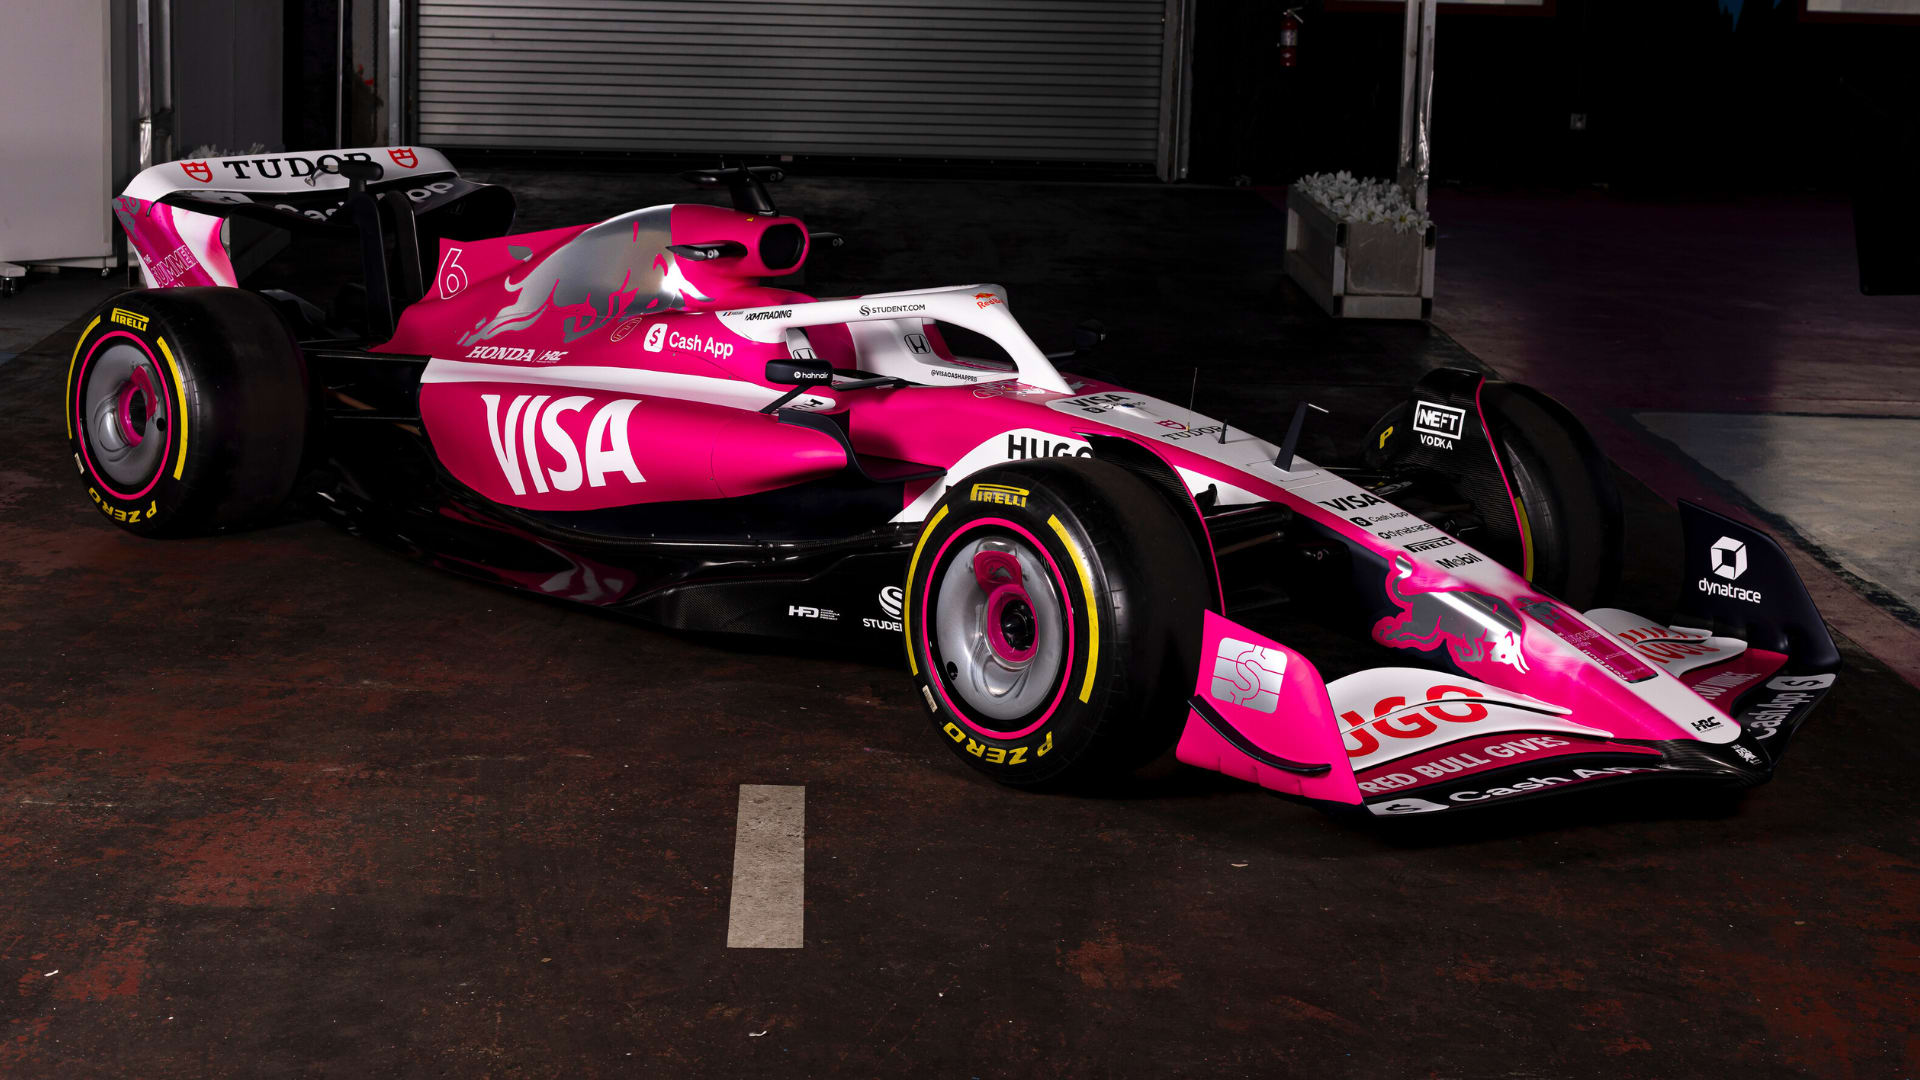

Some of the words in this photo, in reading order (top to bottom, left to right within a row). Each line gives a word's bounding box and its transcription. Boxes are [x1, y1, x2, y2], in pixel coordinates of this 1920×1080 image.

[438, 248, 468, 300] 6
[110, 307, 150, 332] PIRELLI
[871, 304, 926, 314] STUDENT.COM
[465, 346, 536, 362] HONDA
[669, 331, 702, 352] Cash
[703, 336, 734, 360] App
[1418, 408, 1459, 432] NEFT
[480, 394, 647, 496] VISA
[1420, 434, 1453, 450] VODKA
[88, 487, 142, 524] ZERO
[970, 484, 1030, 508] PIRELLI
[1318, 493, 1385, 512] VISA
[146, 501, 158, 518] P
[1368, 513, 1391, 523] Cash
[1391, 511, 1411, 520] App
[1386, 524, 1434, 537] dynatrace
[1402, 536, 1457, 553] PIRELLI
[1435, 553, 1483, 569] Mobil
[1699, 578, 1761, 604] dynatrace
[1755, 692, 1815, 709] App
[1746, 709, 1792, 740] Cash
[943, 721, 1028, 766] ZERO
[1036, 731, 1054, 758] P
[1357, 772, 1417, 794] RED
[1412, 752, 1491, 779] BULL
[1484, 736, 1570, 759] GIVES
[1449, 775, 1573, 802] Cash
